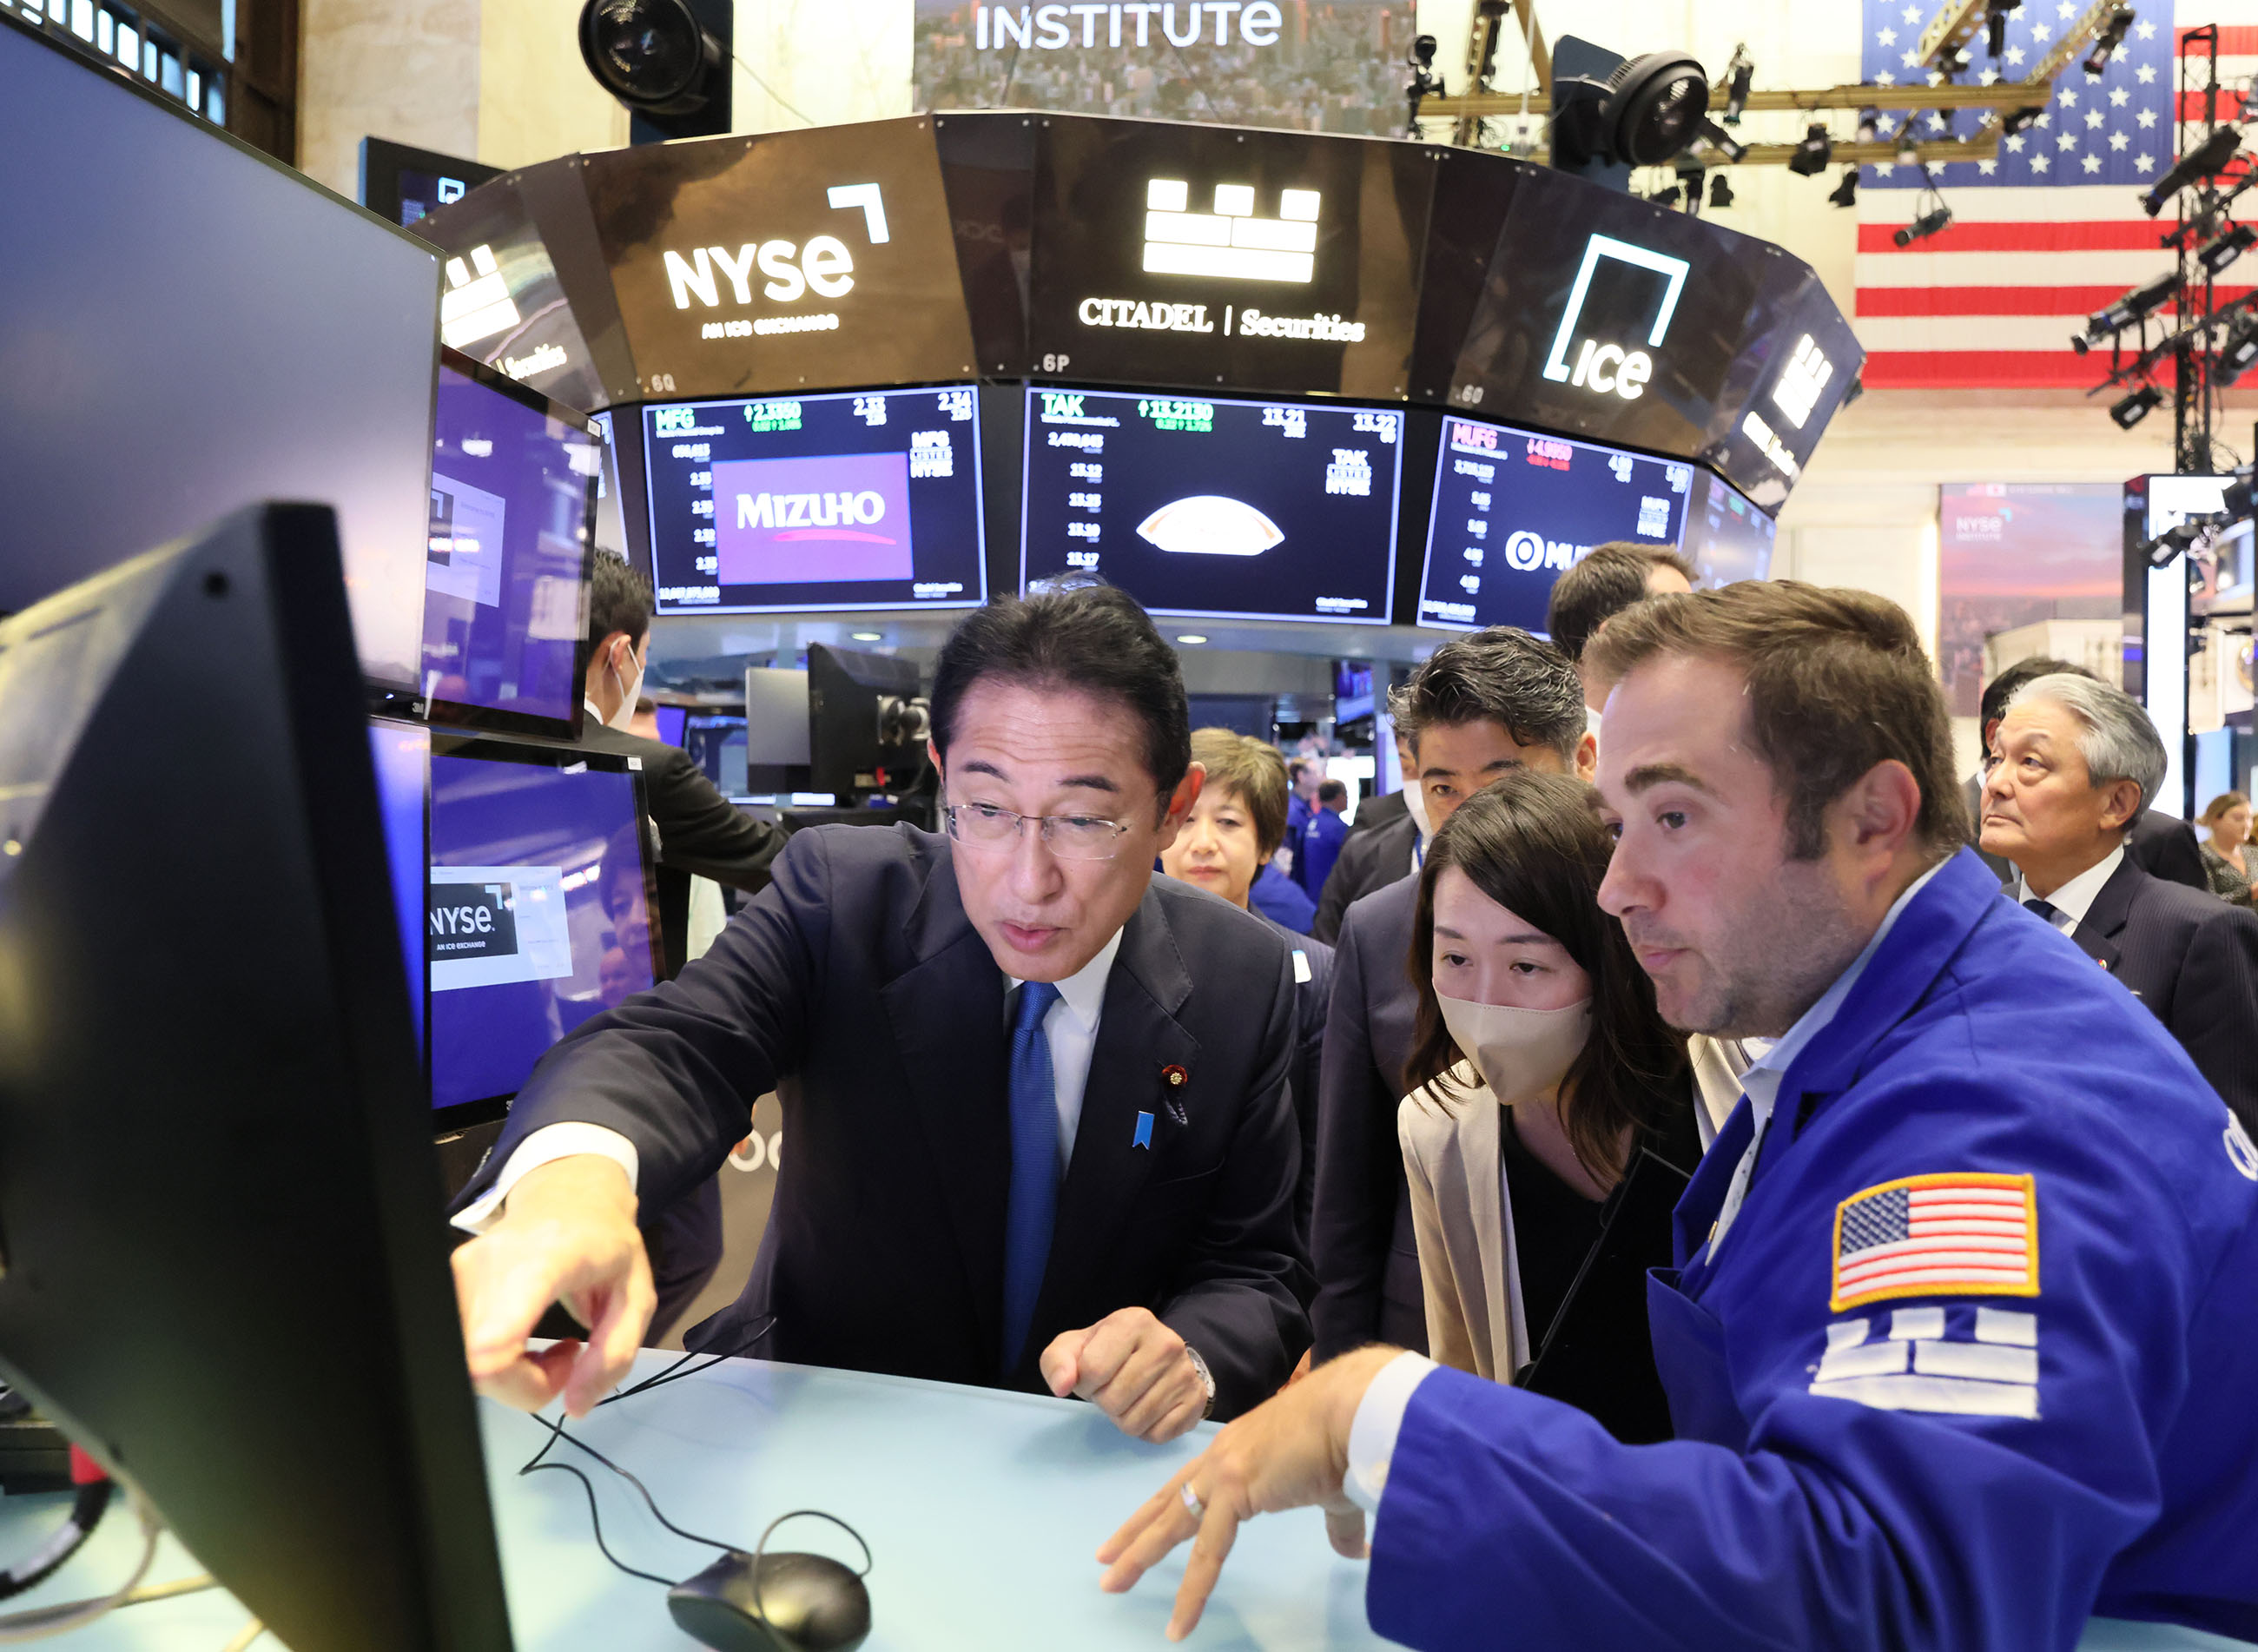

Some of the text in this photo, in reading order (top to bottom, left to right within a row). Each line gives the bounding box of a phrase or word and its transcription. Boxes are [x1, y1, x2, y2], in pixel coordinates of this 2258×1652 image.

[1079, 298, 1366, 342] CITADEL Securities
[1043, 353, 1070, 373] 6P
[656, 407, 695, 430] MFG
[1041, 393, 1397, 433] TAK 13.2130 13.21 13.22
[1452, 423, 1498, 449] MUFG
[1331, 448, 1369, 466] TAK
[736, 491, 885, 529] MIZUHO
